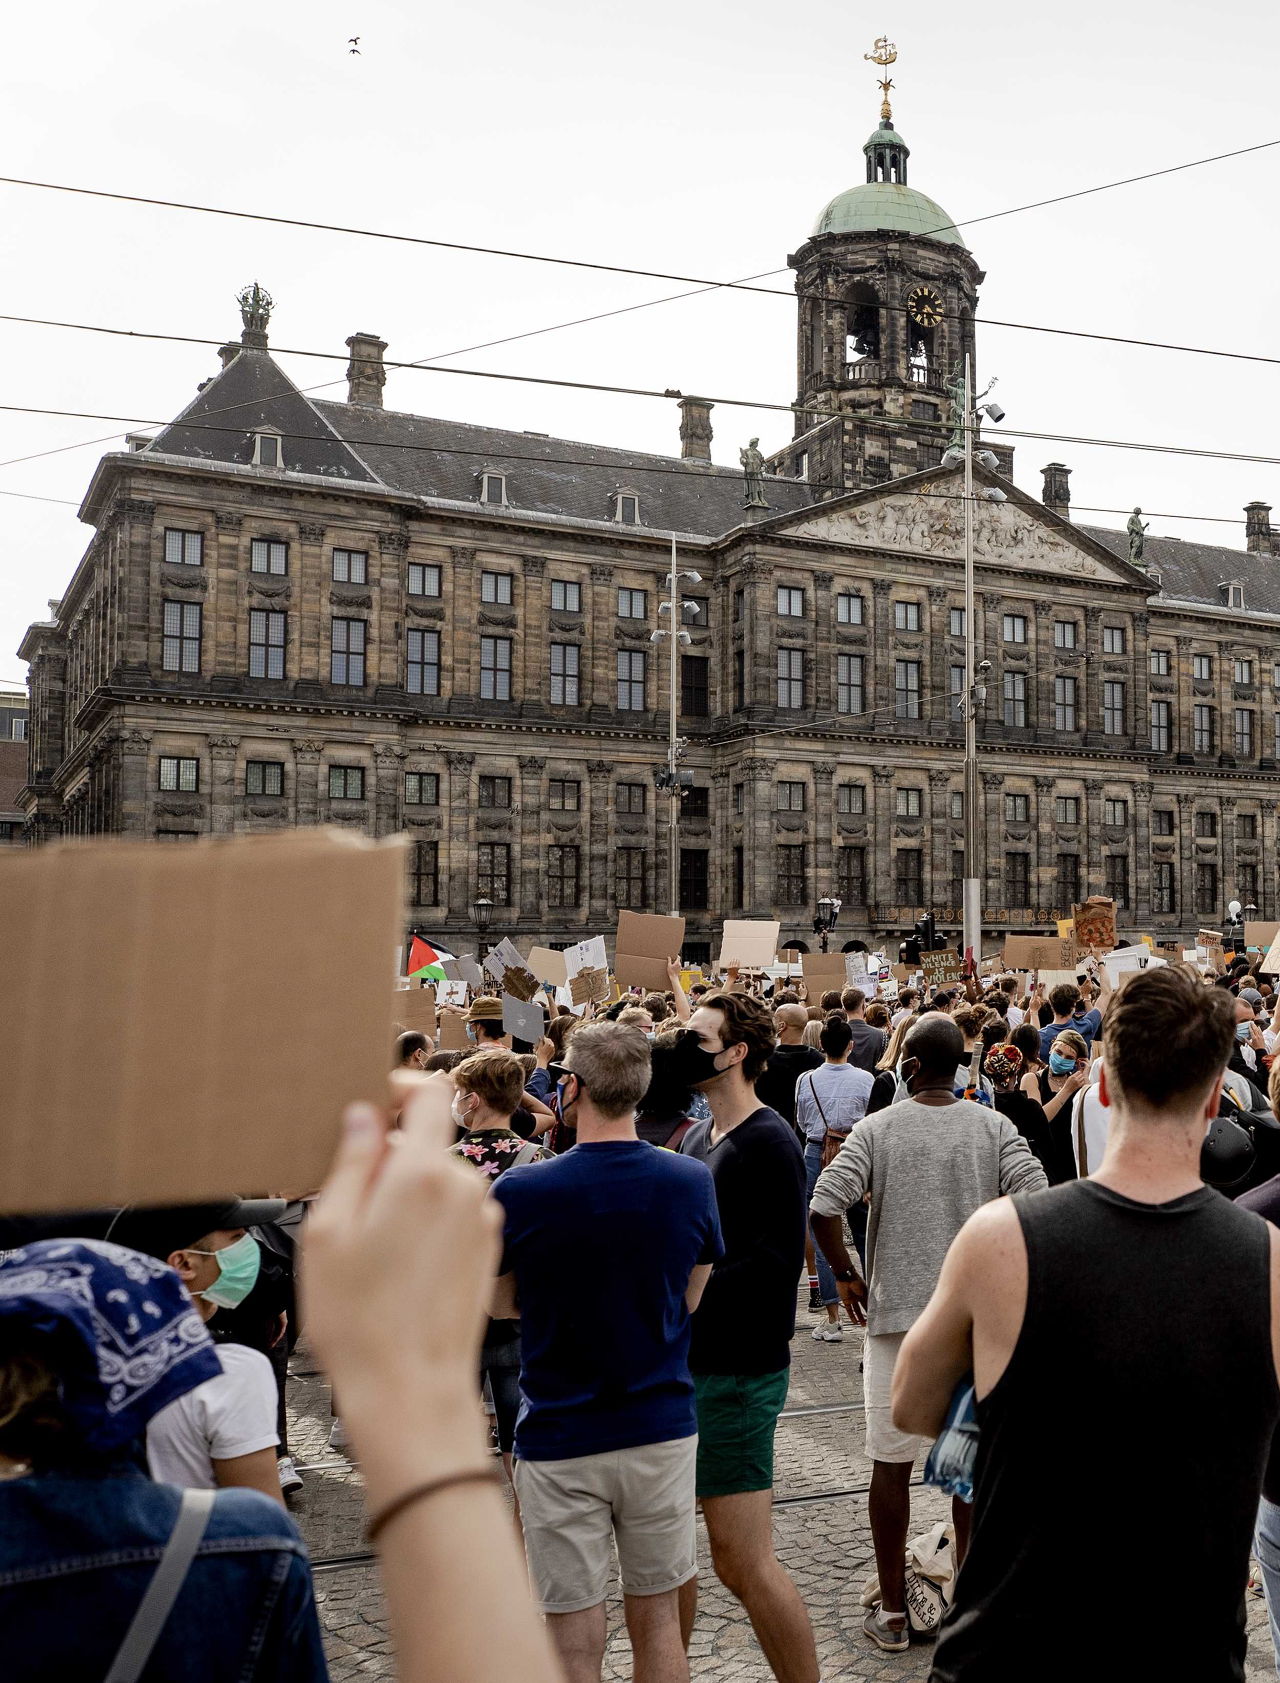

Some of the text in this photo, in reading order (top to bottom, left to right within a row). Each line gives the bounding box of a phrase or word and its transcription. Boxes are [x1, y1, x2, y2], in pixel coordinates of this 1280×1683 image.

[921, 954, 953, 964] WHITE
[921, 960, 956, 969] SILENCE
[933, 967, 945, 975] IS
[929, 971, 963, 985] VIOLENC
